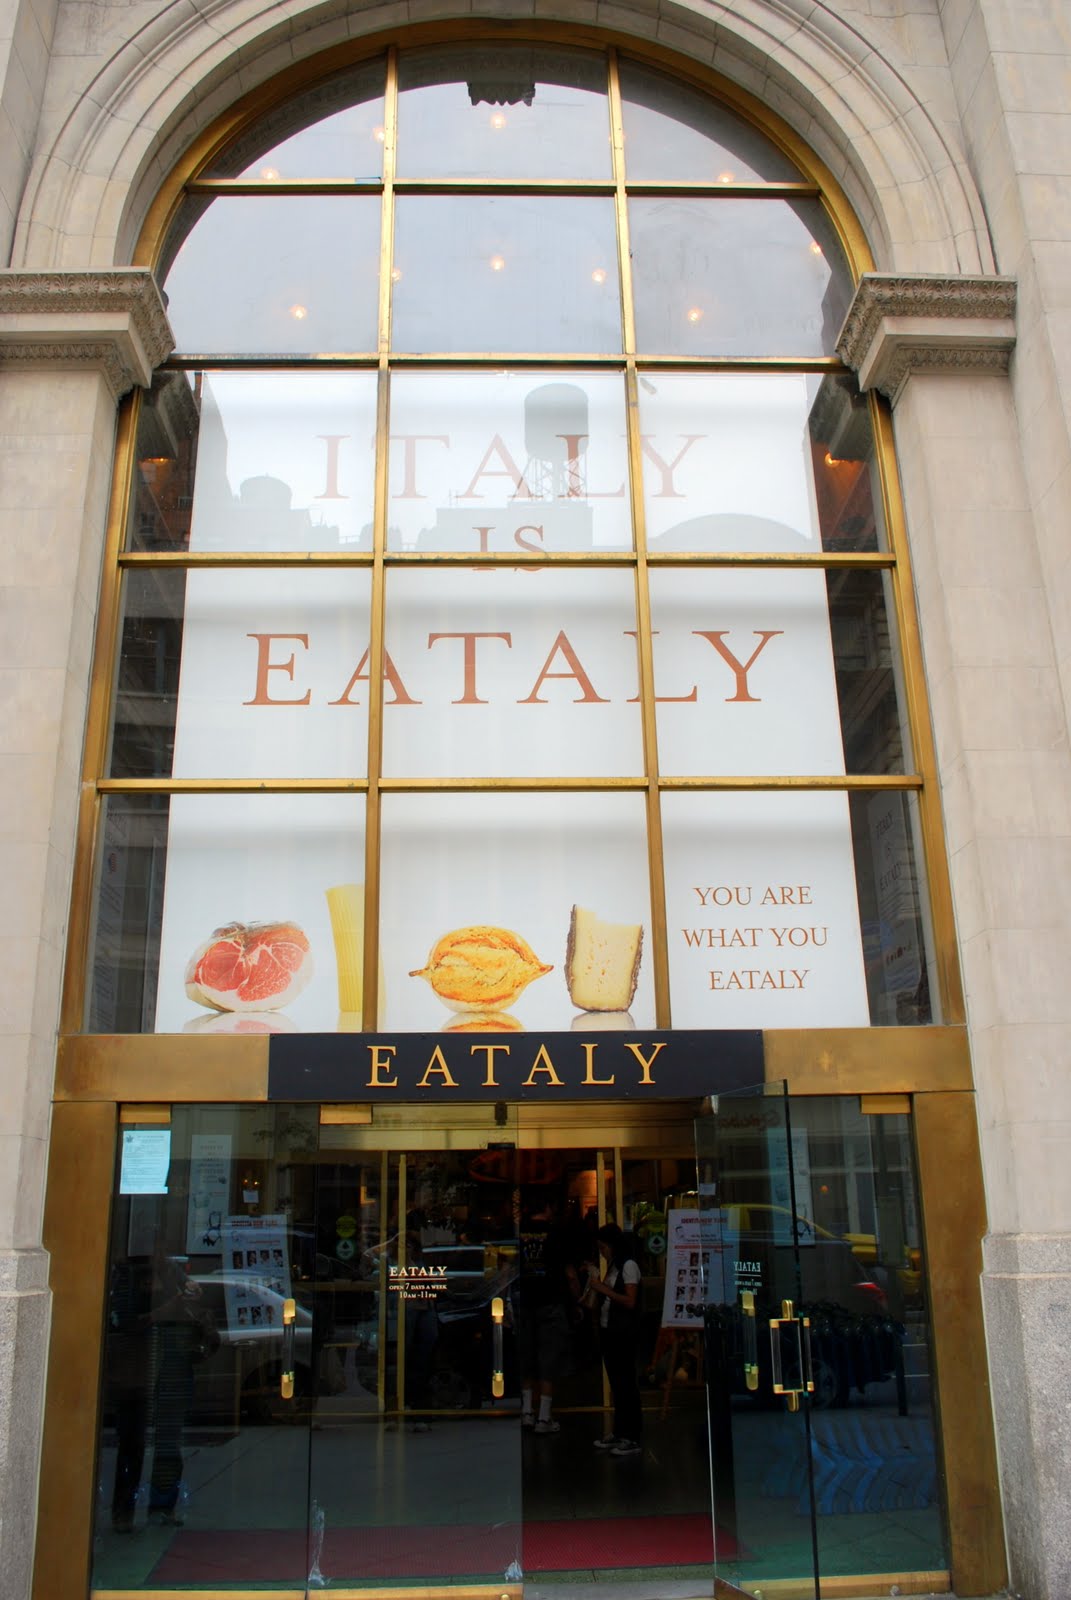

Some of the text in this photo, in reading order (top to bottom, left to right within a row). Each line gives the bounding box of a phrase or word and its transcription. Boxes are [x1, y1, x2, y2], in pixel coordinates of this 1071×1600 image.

[313, 432, 708, 499] ITALY
[472, 524, 544, 572] IS
[693, 886, 813, 906] YOU ARE
[682, 927, 828, 947] WHAT YOU
[709, 969, 810, 990] EATALY
[366, 1043, 667, 1087] EATALY
[389, 1266, 448, 1277] EATALY
[405, 1282, 410, 1290] 7
